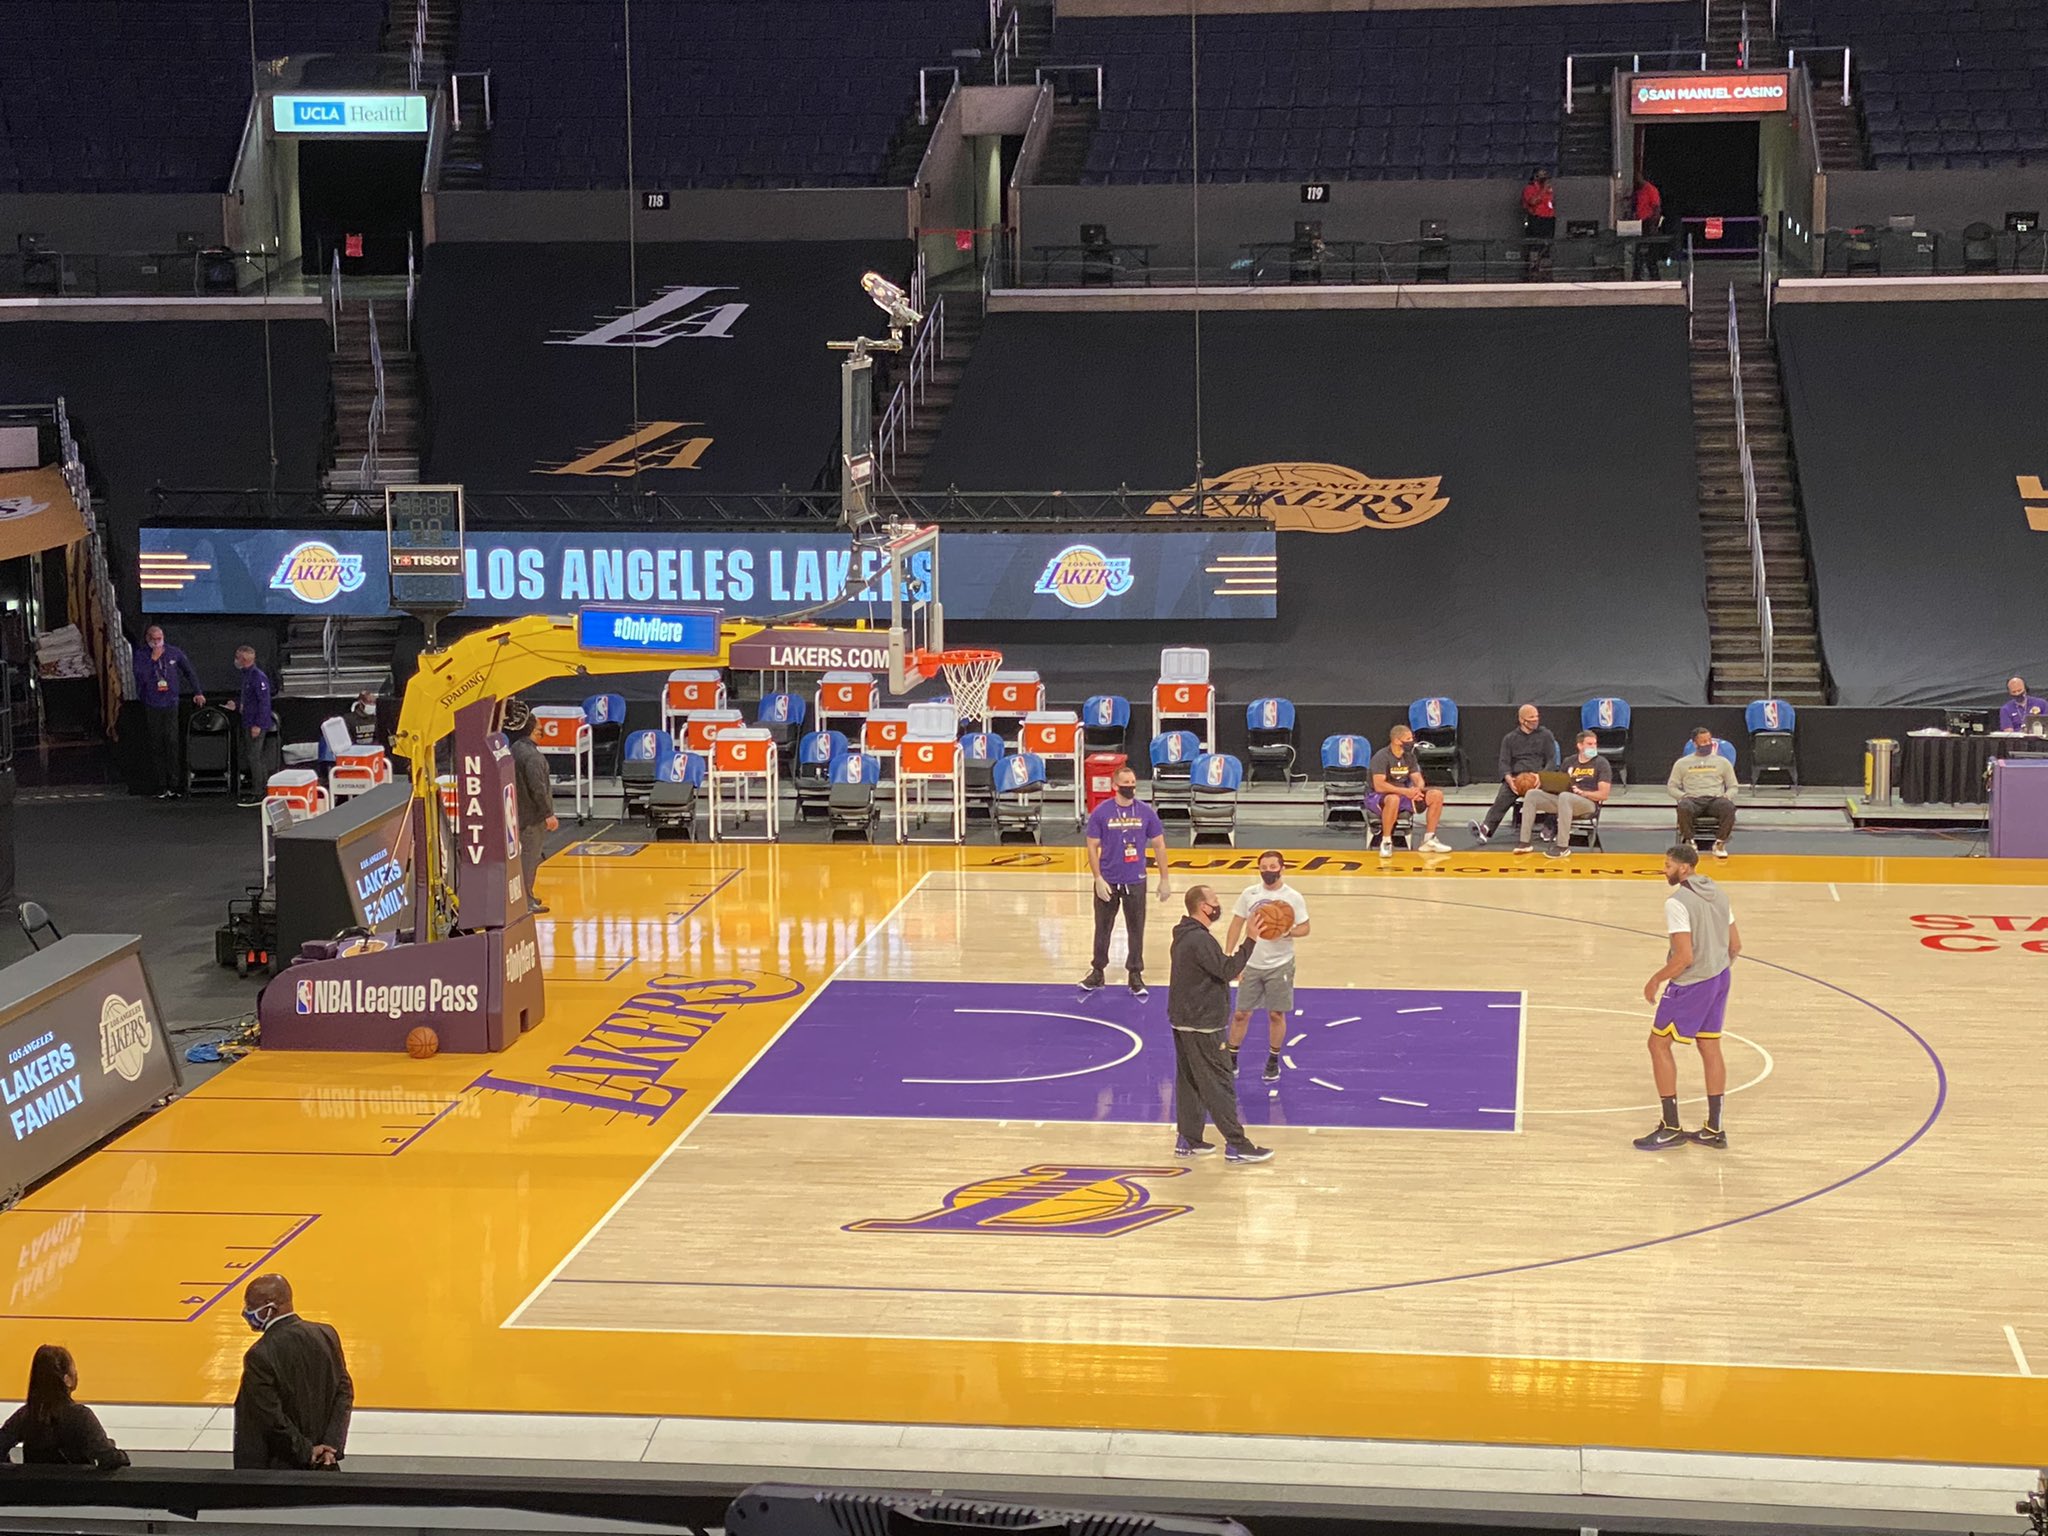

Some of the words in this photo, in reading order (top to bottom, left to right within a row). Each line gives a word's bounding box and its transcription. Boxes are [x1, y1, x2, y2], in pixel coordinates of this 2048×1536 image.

[1649, 88, 1675, 101] SAN
[1678, 87, 1732, 100] MANUEL
[1733, 86, 1783, 99] CASINO
[300, 107, 340, 120] UCLA
[351, 105, 407, 121] Health
[648, 195, 664, 207] 118
[1307, 187, 1324, 200] 119
[1299, 480, 1431, 491] ANGELES
[412, 555, 459, 566] TISSOT
[275, 558, 362, 588] LAKERS
[465, 548, 545, 599] LOS
[561, 549, 754, 600] ANGELES
[1040, 562, 1130, 592] LAKERS
[613, 616, 683, 645] #OnlyHere
[770, 646, 890, 669] LAKERS.COM
[441, 672, 485, 709] SPALDING
[684, 684, 699, 700] G
[837, 686, 853, 702] G
[1002, 686, 1017, 702] G
[1174, 687, 1190, 703] G
[544, 721, 558, 737] G
[702, 724, 716, 740] G
[881, 725, 896, 741] G
[1041, 727, 1056, 744] G
[731, 744, 747, 760] G
[917, 745, 934, 762] G
[465, 756, 483, 816] NBA
[468, 825, 484, 864] TV
[356, 859, 402, 900] LAKERS
[363, 883, 408, 925] FAMILY
[314, 980, 352, 1014] NBA
[356, 980, 426, 1019] League
[430, 979, 478, 1013] Pass
[8, 1047, 22, 1064] LOS
[22, 1031, 55, 1056] ANGELES
[102, 1015, 149, 1067] LAKERS
[462, 969, 805, 1126] LAKERS
[0, 1043, 76, 1105] LAKERS
[10, 1074, 84, 1141] FAMILY
